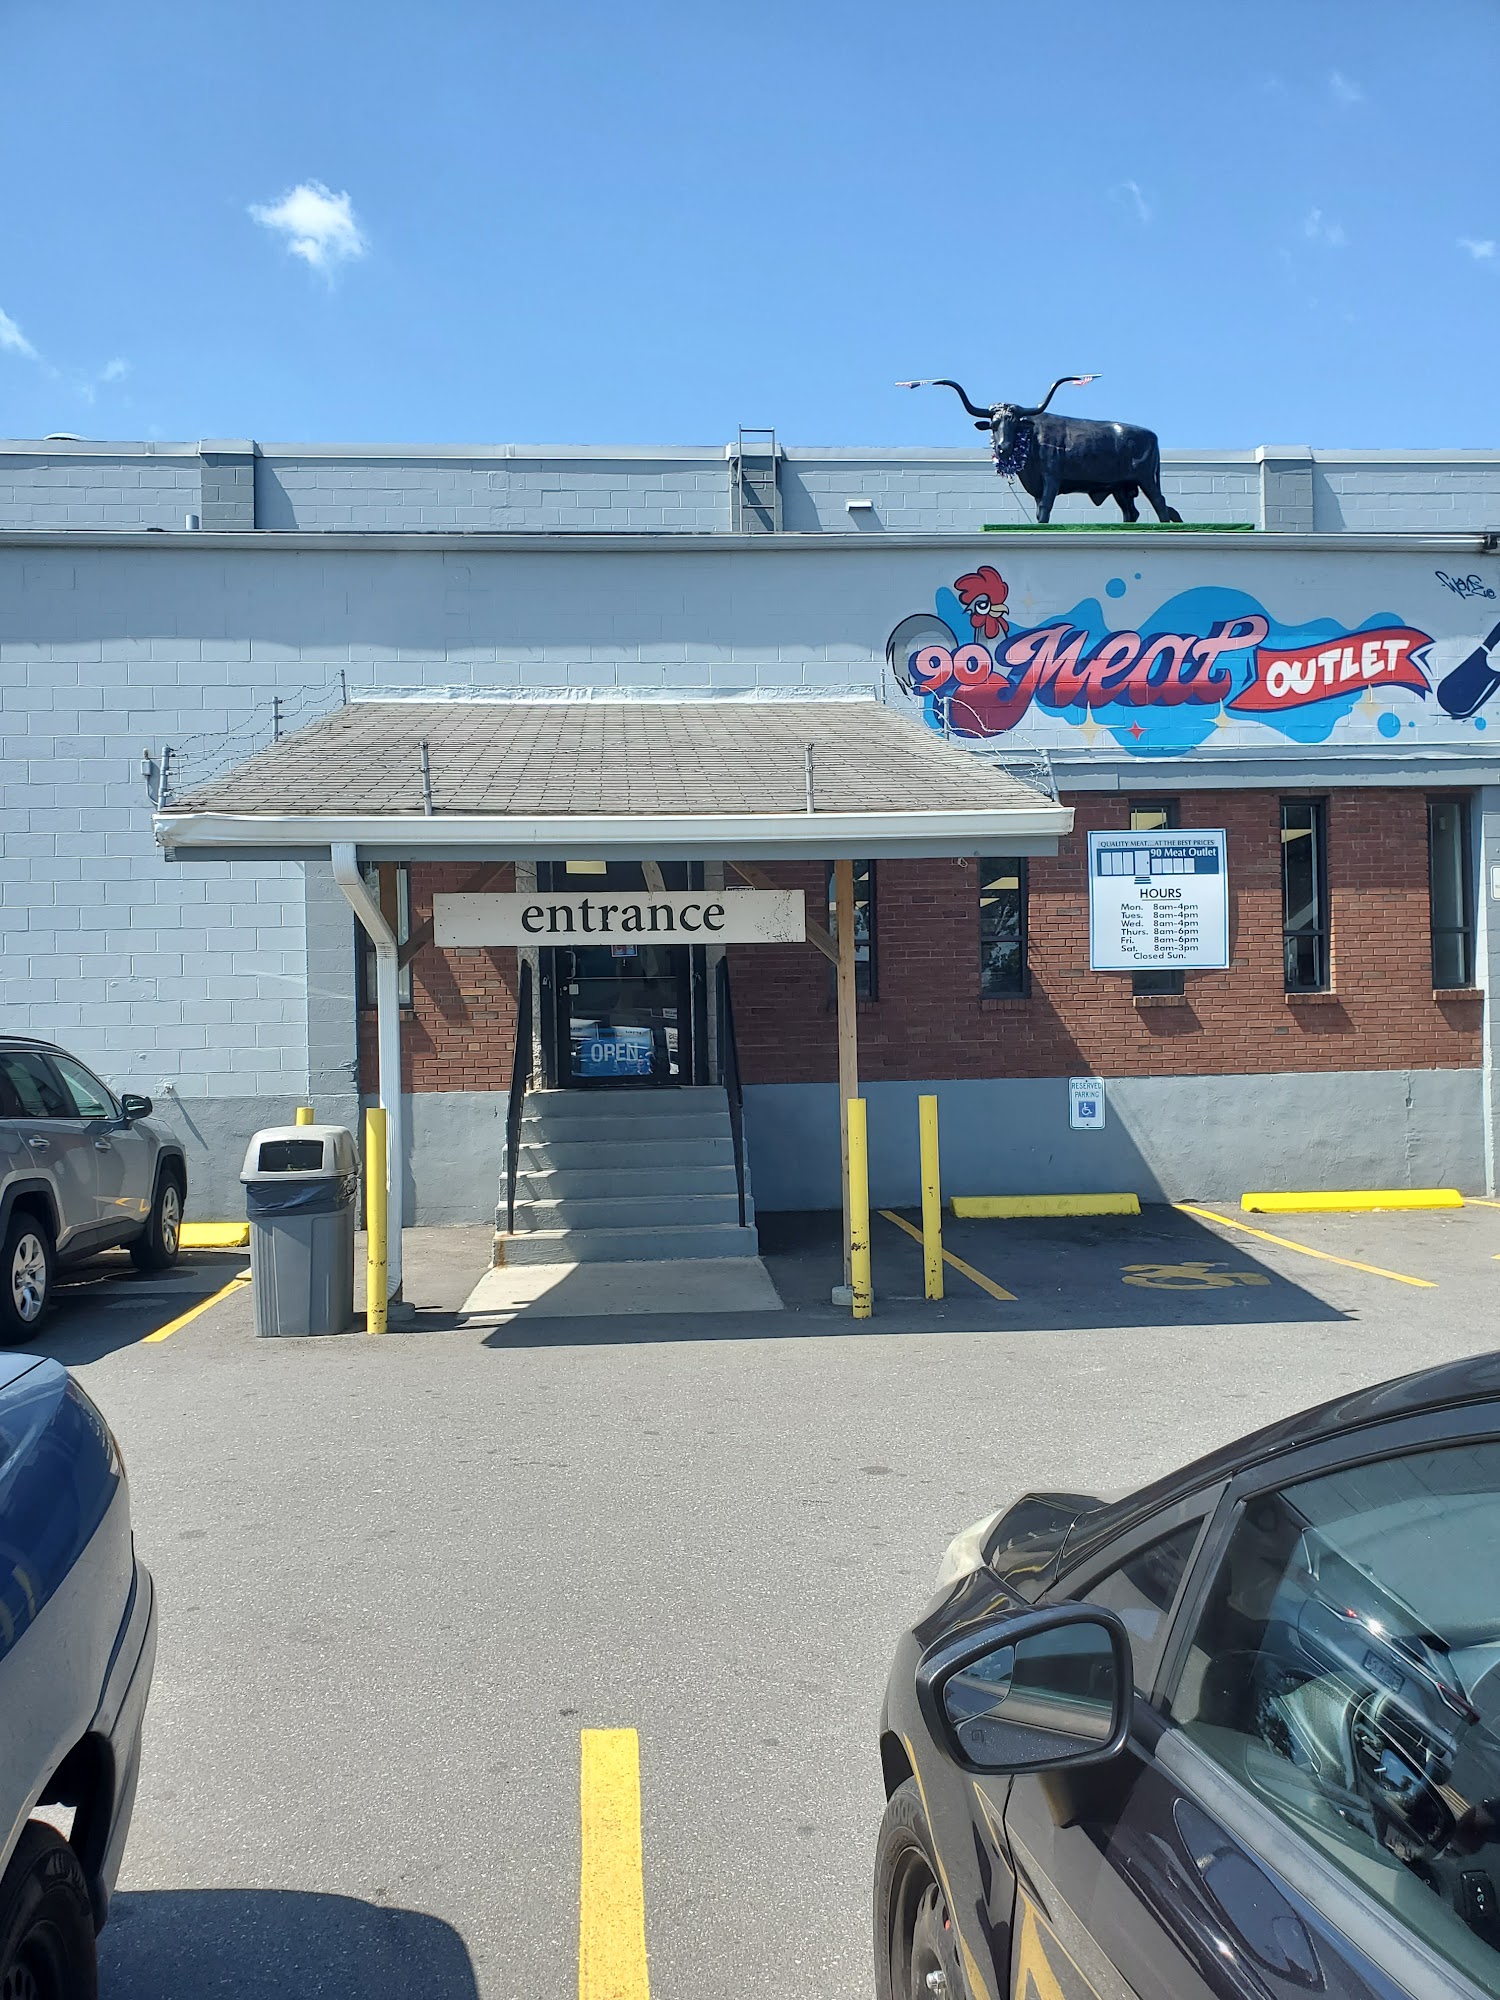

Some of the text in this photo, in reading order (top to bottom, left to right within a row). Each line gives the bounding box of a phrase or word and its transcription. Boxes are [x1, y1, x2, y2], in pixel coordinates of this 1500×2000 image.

[909, 614, 1410, 734] 90 Meat OUTLET
[1150, 847, 1217, 857] 90 Meat Outlet
[1140, 888, 1182, 898] HOURS
[1120, 903, 1199, 911] Mon. 8am-4pm
[521, 898, 726, 934] entrance
[1121, 911, 1199, 920] Tues. 8am-4pm
[1121, 919, 1199, 928] Wed. 8am-4pm
[1121, 927, 1199, 936] Thurs. 8am-6pm
[1120, 935, 1199, 945] Fri. 8am-6pm
[1154, 944, 1199, 953] 8am-3pm
[1133, 951, 1187, 960] Closed Sun.
[590, 1042, 640, 1063] OPEN
[1071, 1082, 1102, 1090] RESERVED
